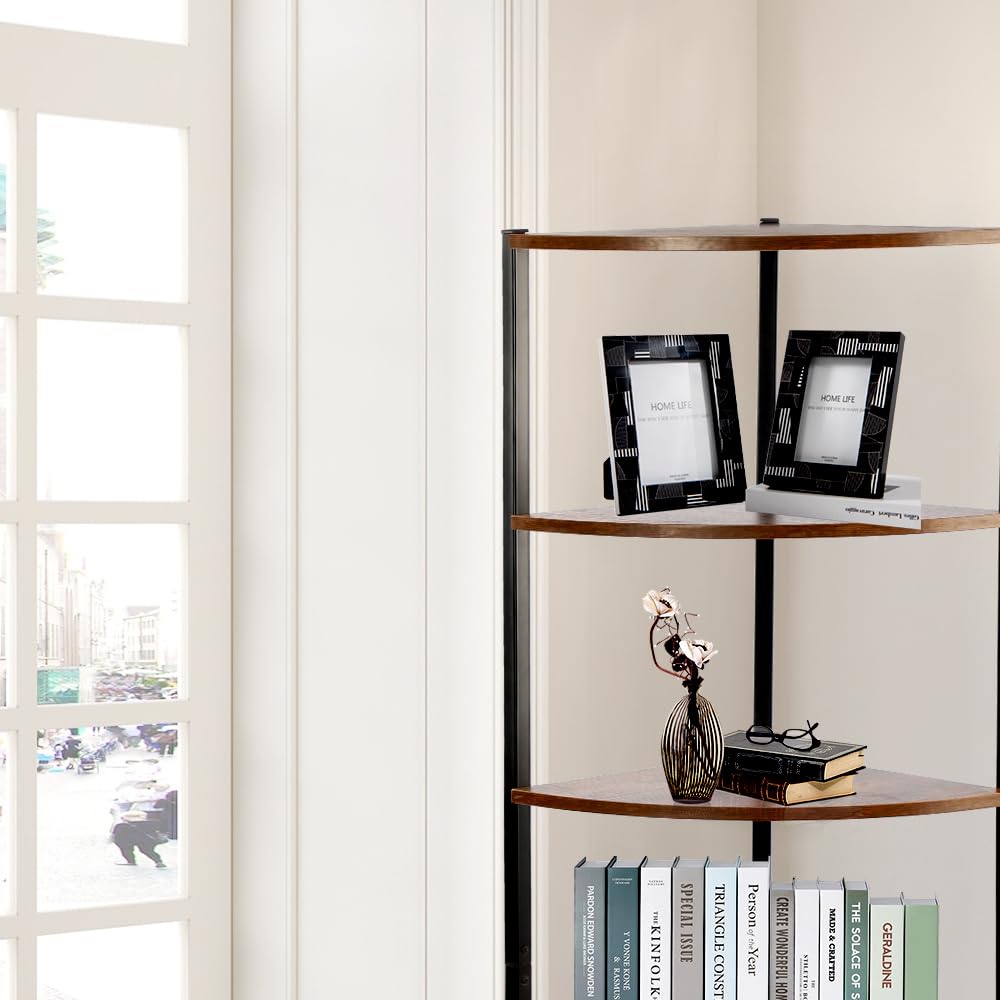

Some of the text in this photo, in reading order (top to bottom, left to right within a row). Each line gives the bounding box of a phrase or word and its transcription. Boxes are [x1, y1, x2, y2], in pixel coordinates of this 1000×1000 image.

[650, 400, 693, 411] HOME LIFE
[821, 394, 856, 403] HOME LIFE
[680, 883, 694, 963] SPECIAL ISSUE
[714, 883, 726, 952] TRIANGLE
[747, 884, 759, 927] Person
[775, 897, 789, 926] CREATE
[828, 908, 836, 933] MADE
[851, 902, 861, 923] THE
[586, 885, 595, 997] PARDON EDWARD SNOWDEN
[746, 928, 755, 937] of
[851, 928, 861, 969] SOLACE
[650, 925, 661, 996] KINFOLK
[747, 948, 759, 977] Year
[775, 928, 789, 979] WONDERFUL
[828, 943, 836, 982] CRAFTED
[882, 922, 893, 989] GERALDINE
[613, 967, 621, 1000] RASMUS
[851, 973, 861, 989] OF
